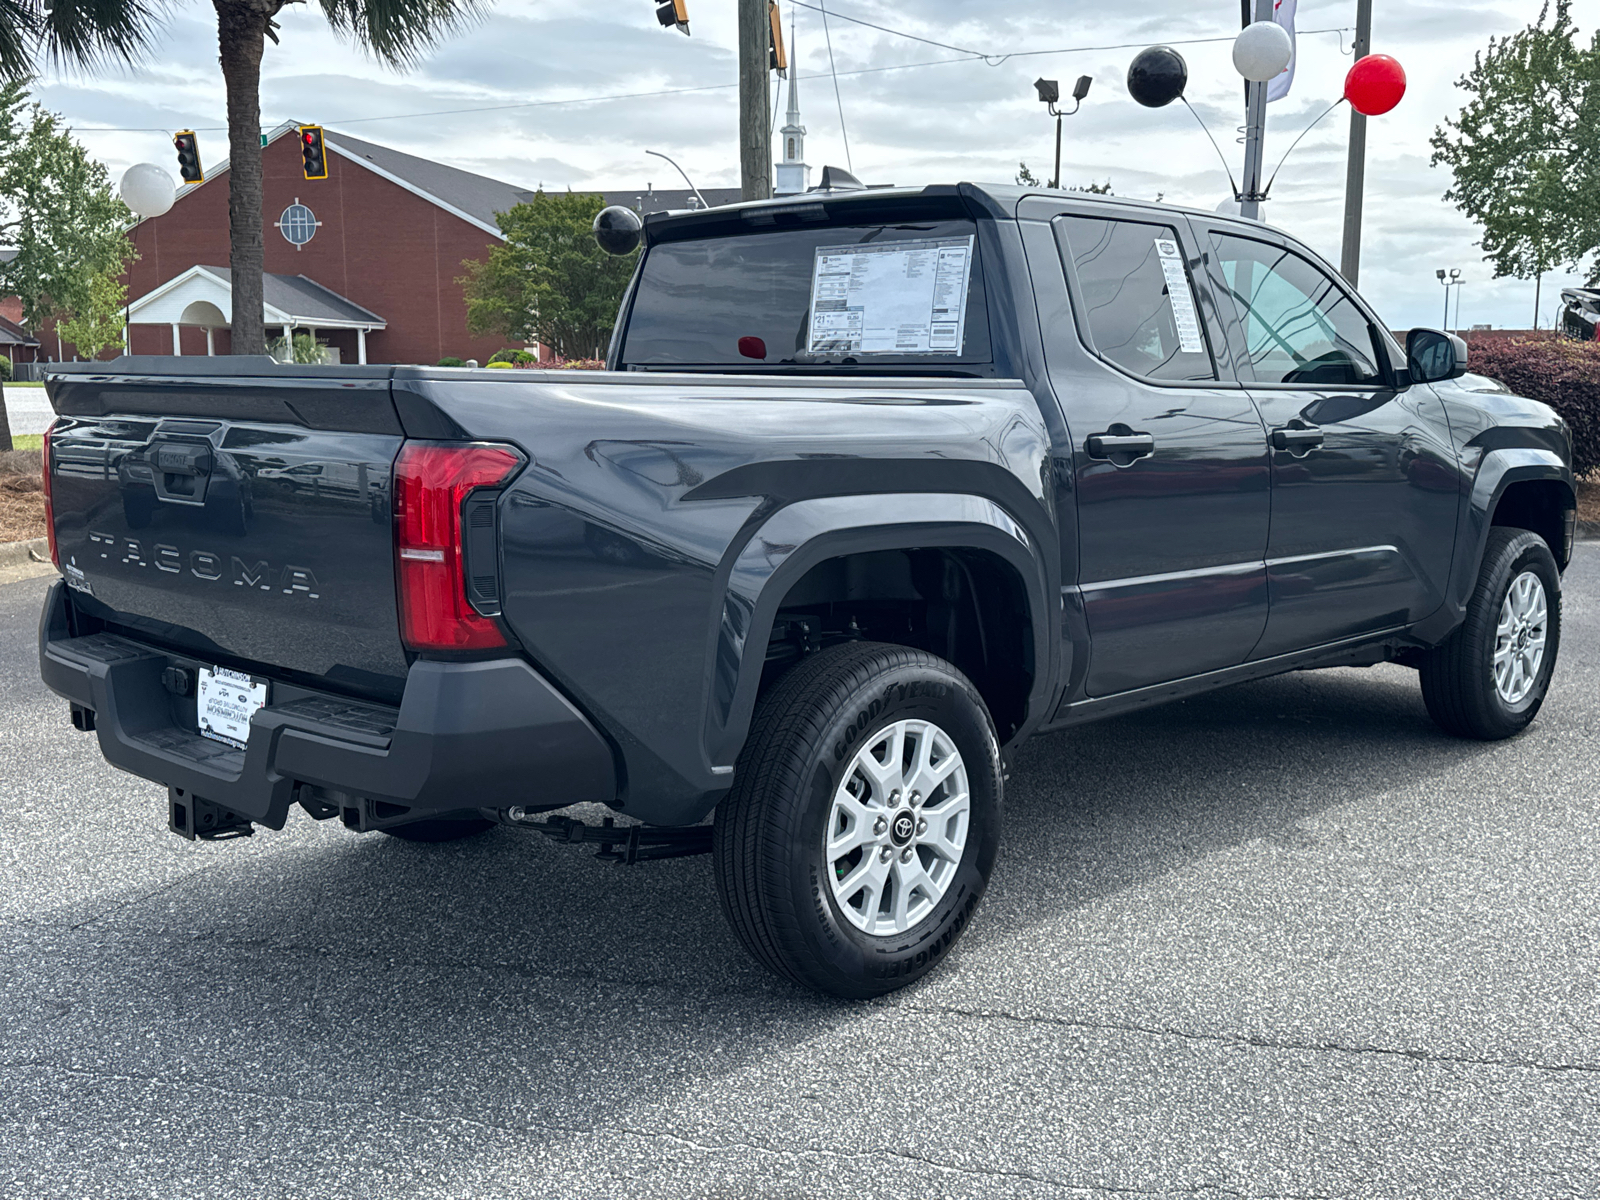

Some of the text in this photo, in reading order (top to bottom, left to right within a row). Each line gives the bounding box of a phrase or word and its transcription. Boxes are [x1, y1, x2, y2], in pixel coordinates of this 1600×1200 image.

[89, 531, 319, 599] TACOMA
[809, 863, 840, 949] TERRITORY
[872, 891, 980, 980] WRANGLER
